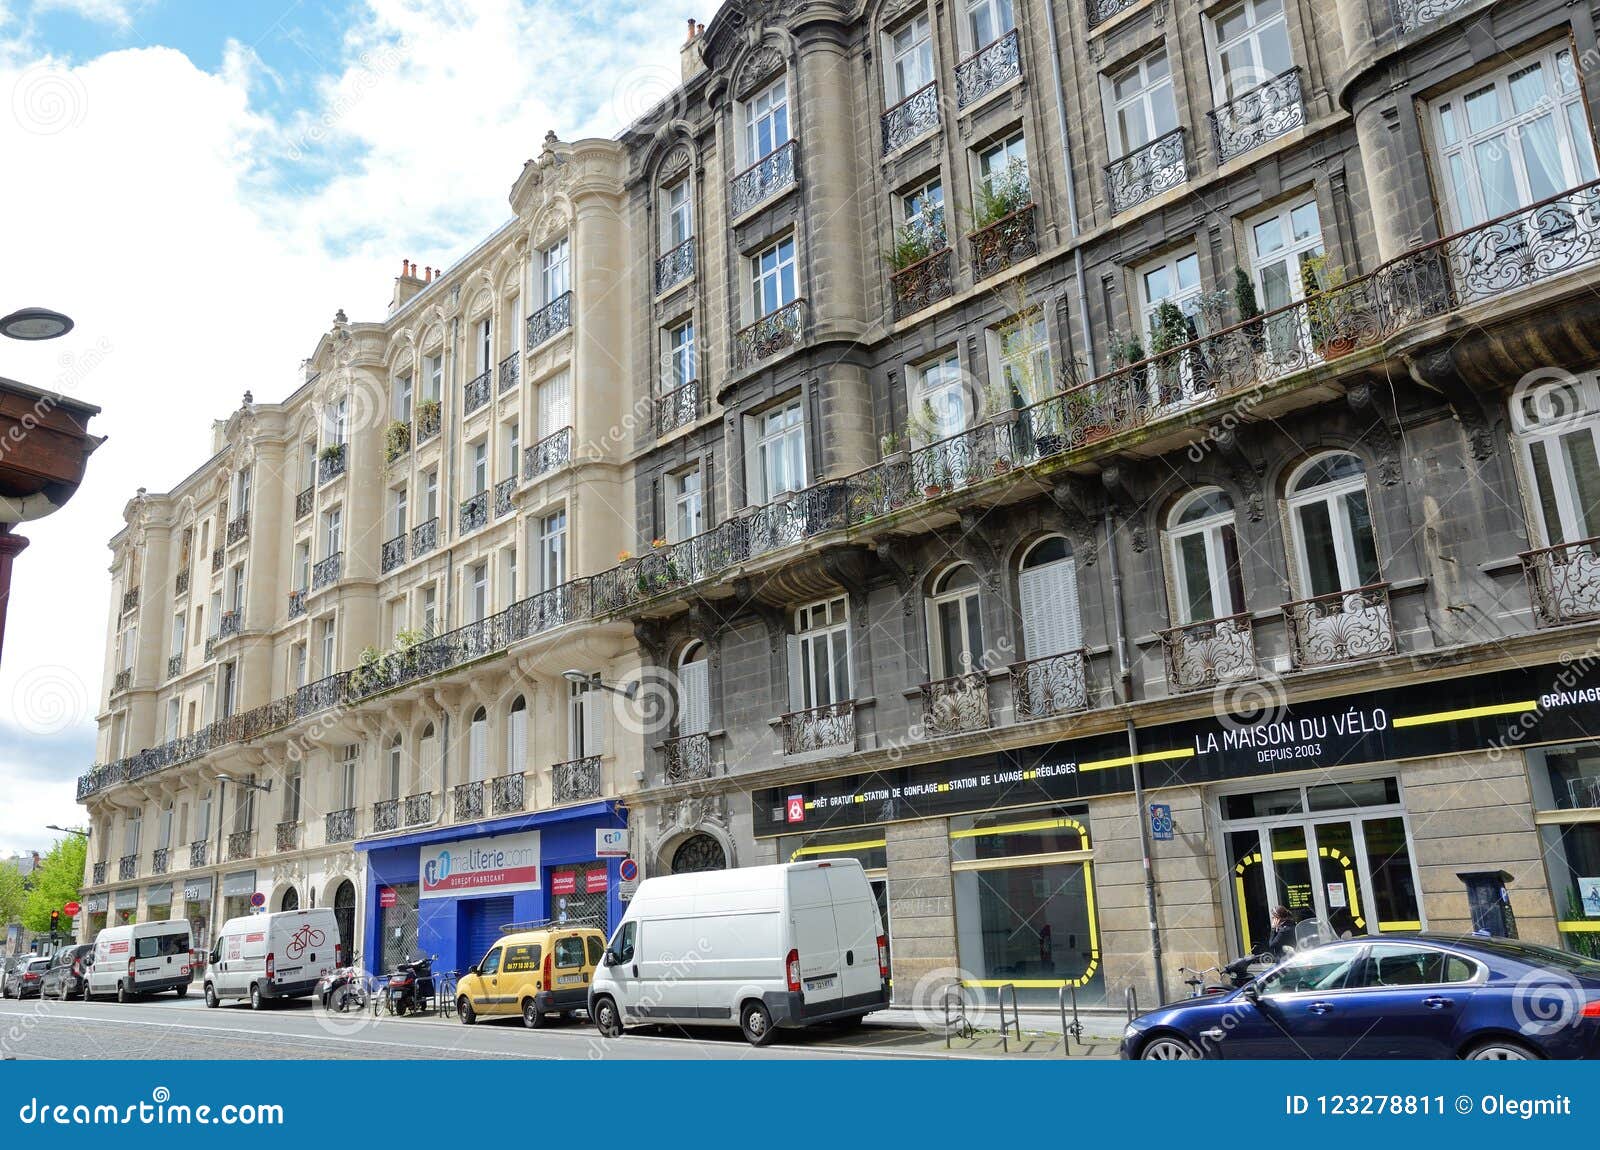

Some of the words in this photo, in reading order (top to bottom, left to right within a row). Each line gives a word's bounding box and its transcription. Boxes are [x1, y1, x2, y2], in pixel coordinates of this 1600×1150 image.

[1195, 732, 1219, 755] LA
[1223, 721, 1295, 751] MAISON
[1300, 717, 1327, 741] DU
[1332, 706, 1387, 736] VÉLO
[1257, 747, 1293, 763] DEPUIS
[1295, 743, 1322, 758] 2003
[1035, 763, 1076, 777] RÉGLAGES
[949, 777, 977, 791] STATION
[980, 775, 991, 786] DE
[994, 770, 1023, 784] LAVAGE
[812, 796, 827, 808] PRÊT
[830, 794, 855, 807] GRATUIT
[863, 788, 889, 802] STATION
[892, 787, 901, 797] DE
[903, 783, 938, 796] GONFLAGE
[452, 848, 533, 872] maliterie.com
[451, 876, 471, 887] DIRECT
[473, 874, 505, 884] FABRICANT
